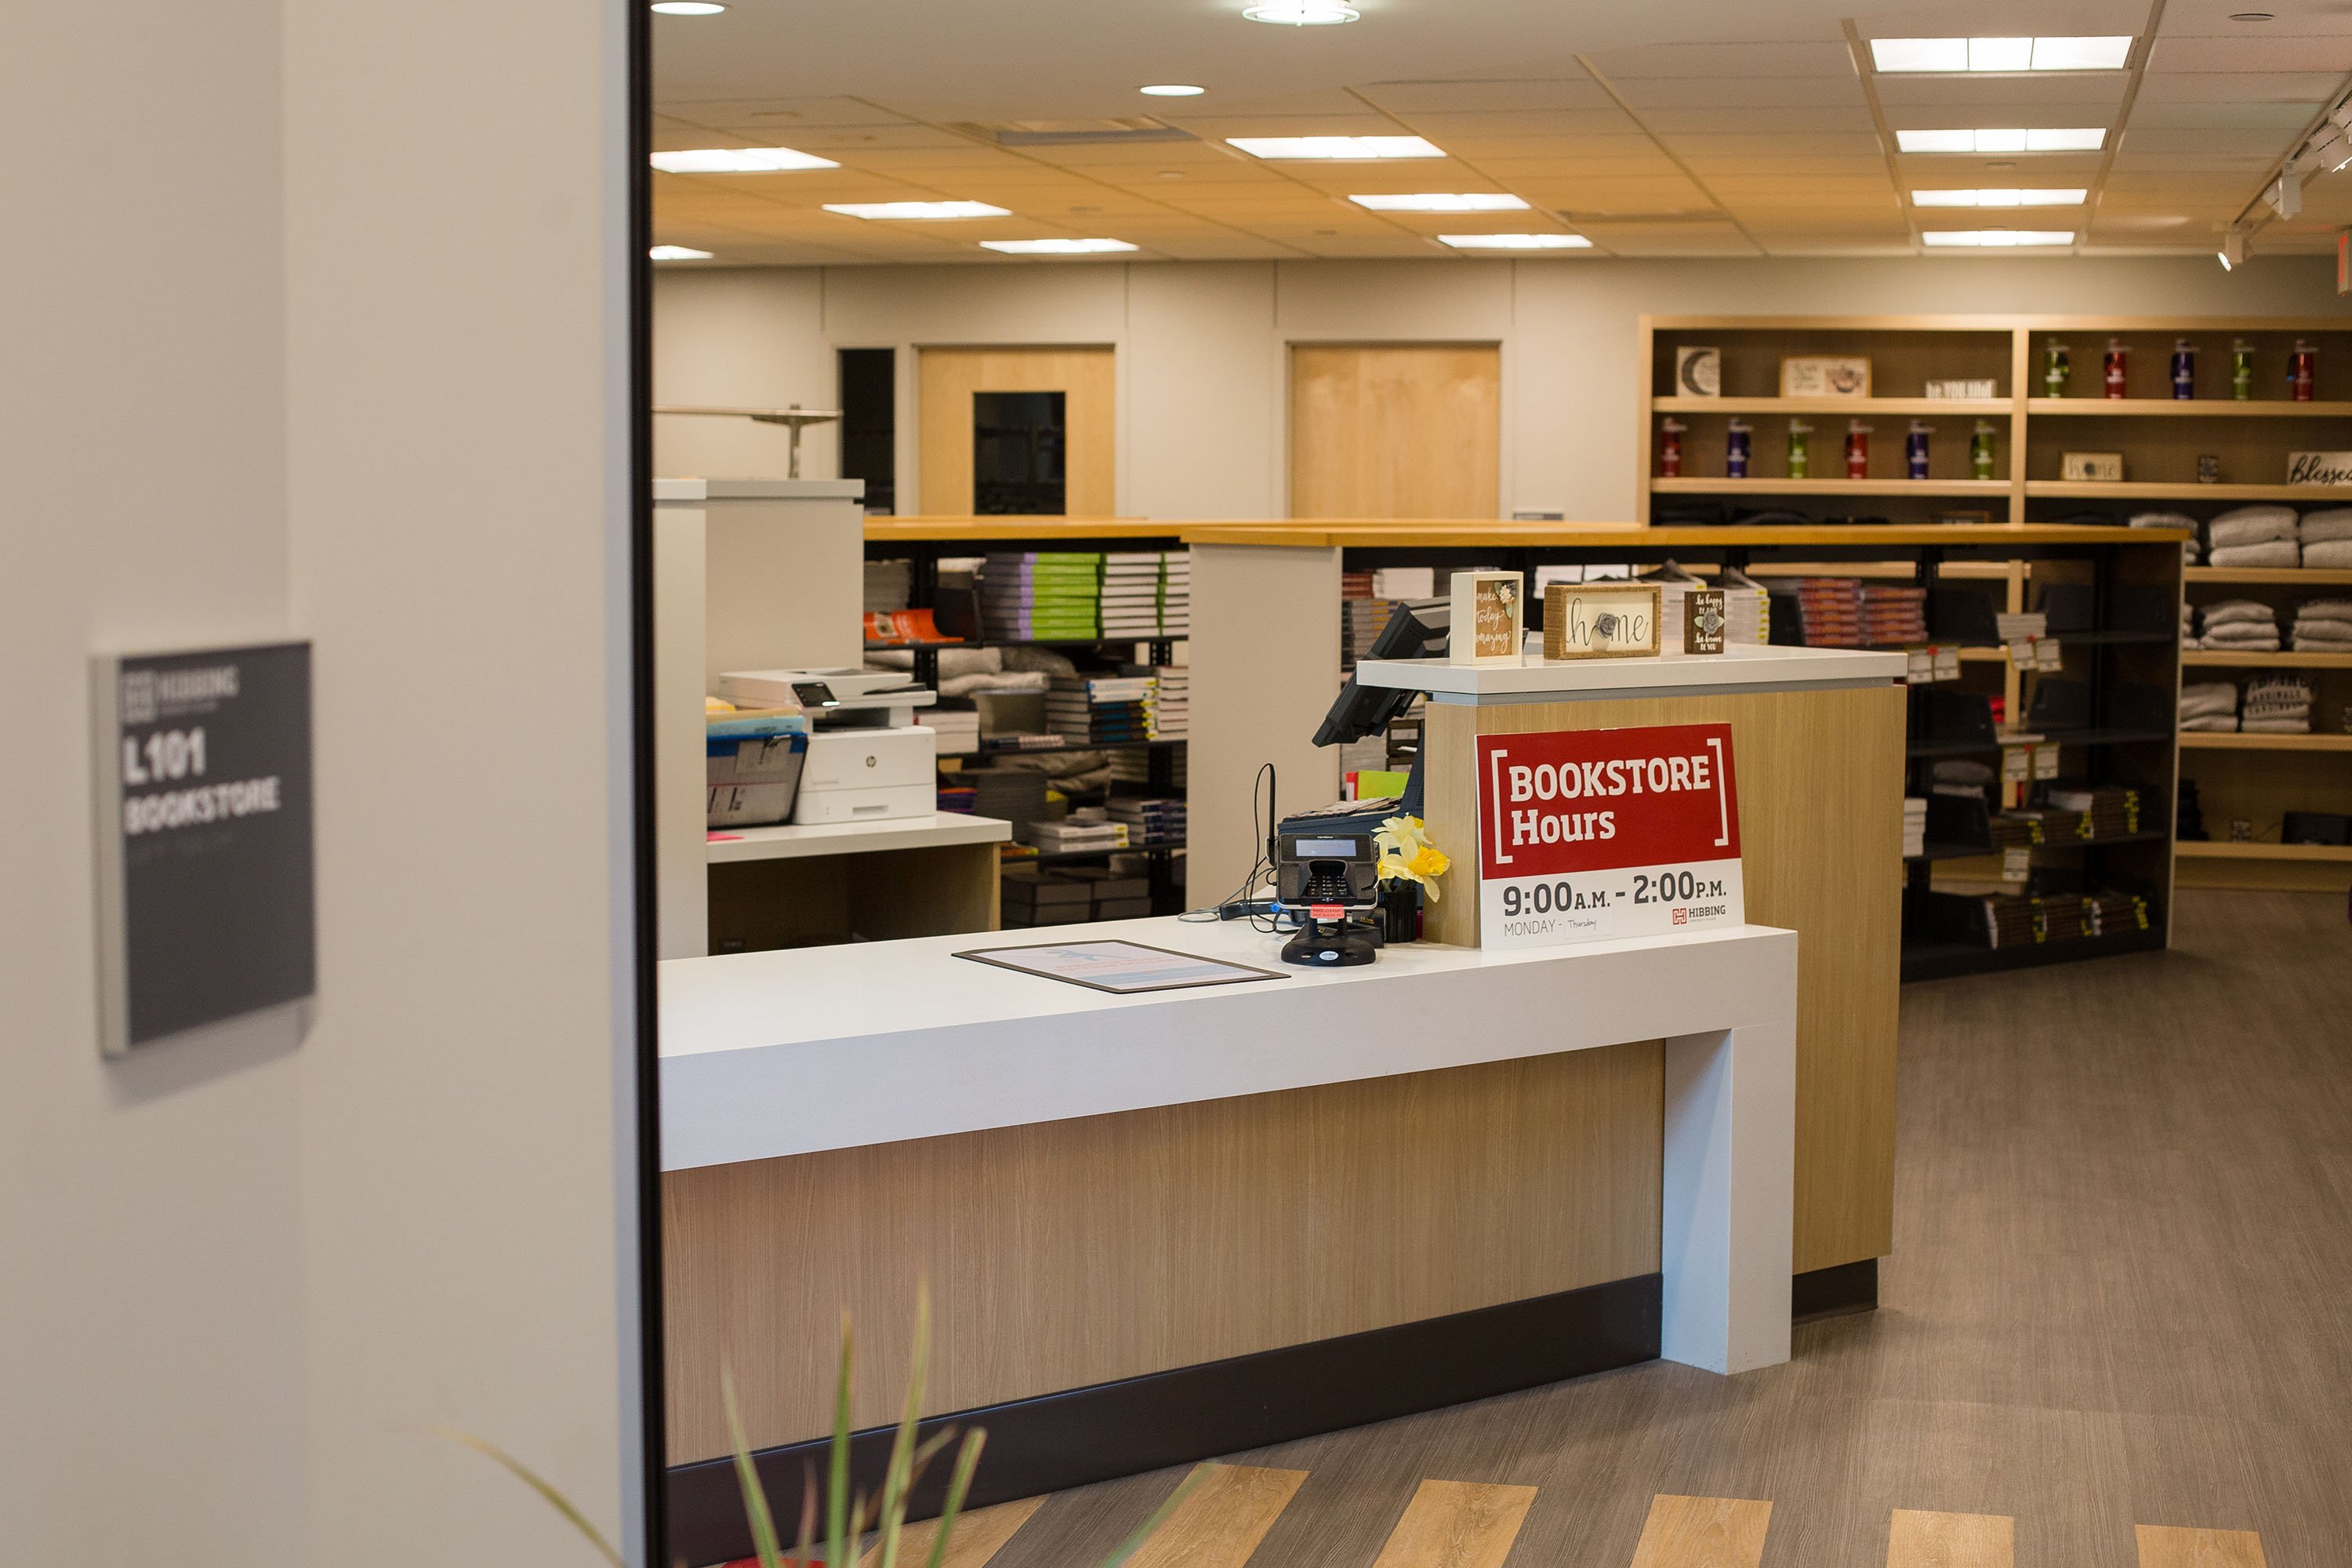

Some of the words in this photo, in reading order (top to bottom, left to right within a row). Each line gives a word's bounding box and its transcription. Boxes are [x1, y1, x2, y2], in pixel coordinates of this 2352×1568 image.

[1475, 606, 1504, 630] today
[122, 726, 207, 785] L101
[1509, 755, 1711, 802] BOOKSTORE
[122, 775, 281, 835] BOOKSTORE
[1512, 808, 1615, 846] Hours
[1568, 918, 1597, 931] Thursday
[1689, 906, 1726, 917] HIBBING
[1504, 919, 1555, 937] MONDAY
